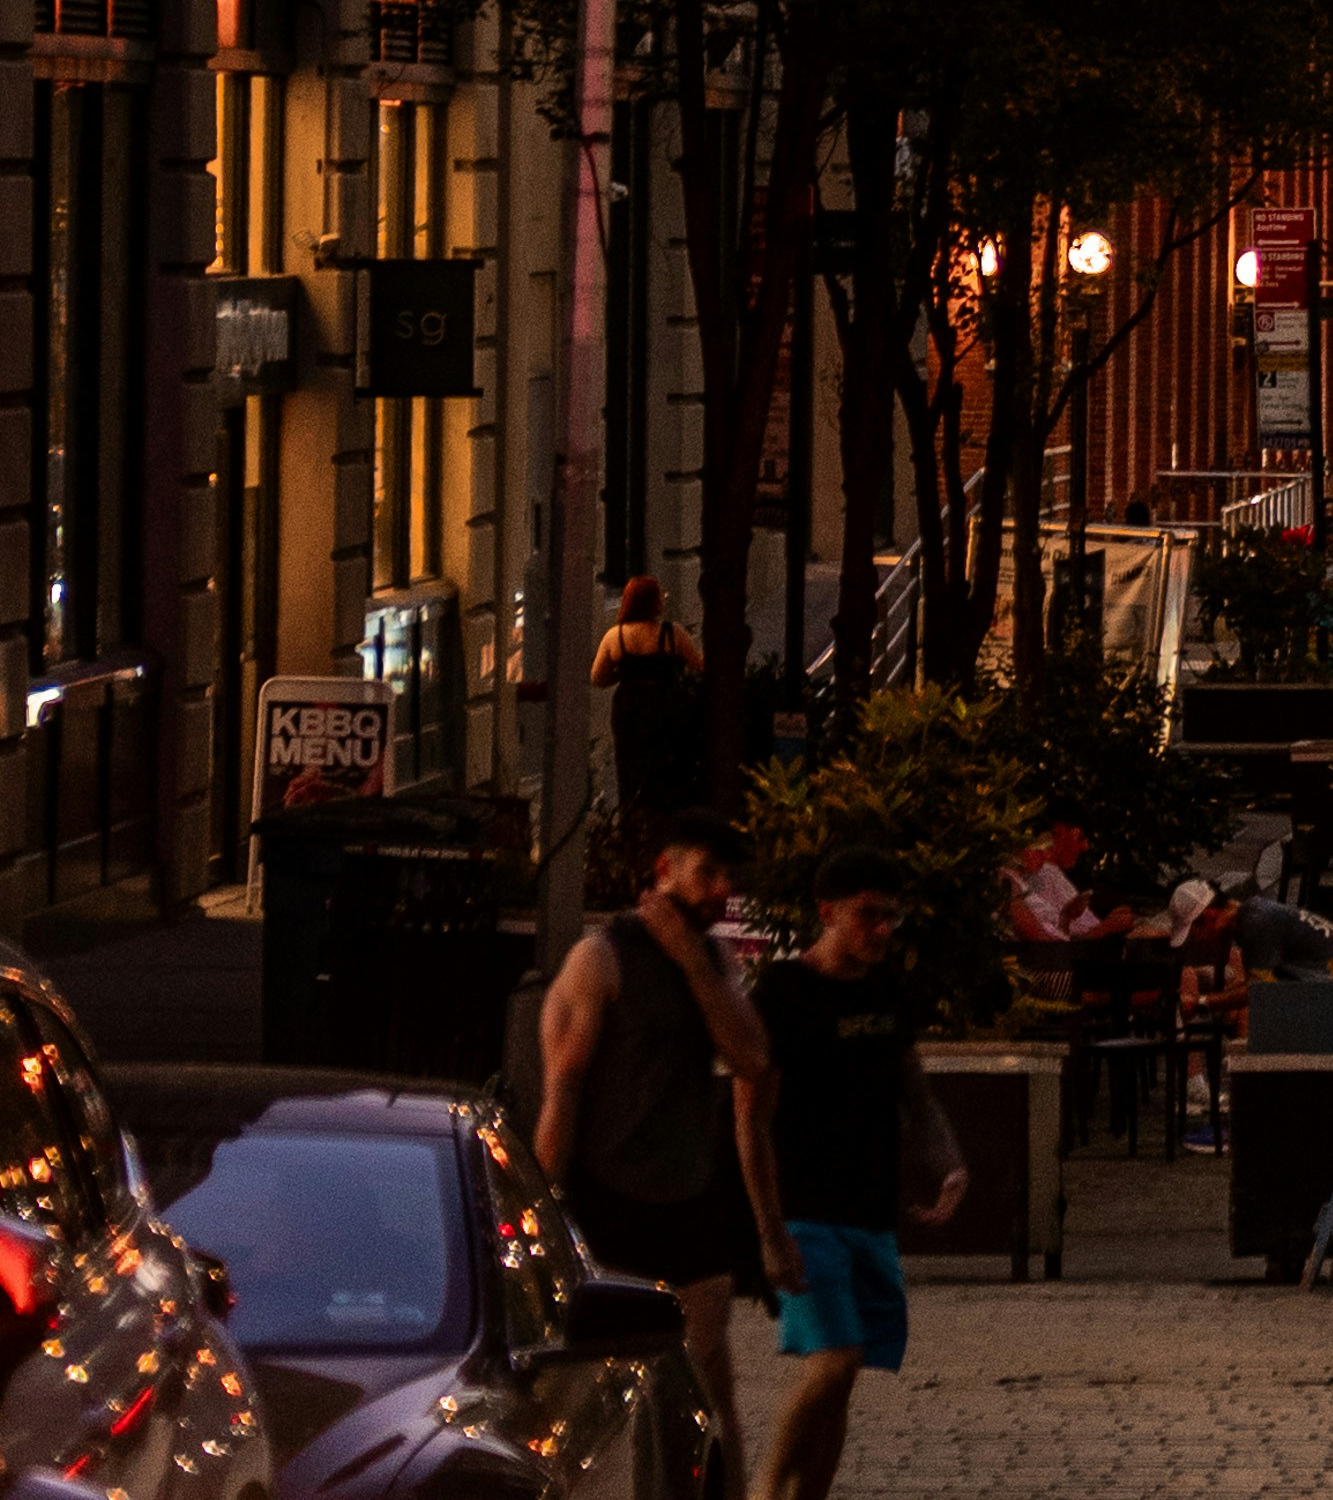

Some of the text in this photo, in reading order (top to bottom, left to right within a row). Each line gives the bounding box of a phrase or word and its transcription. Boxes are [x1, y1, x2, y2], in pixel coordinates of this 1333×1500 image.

[1254, 212, 1304, 222] NO STANDING
[396, 310, 448, 346] sg
[271, 706, 382, 739] KBBQ
[269, 736, 381, 767] MENU
